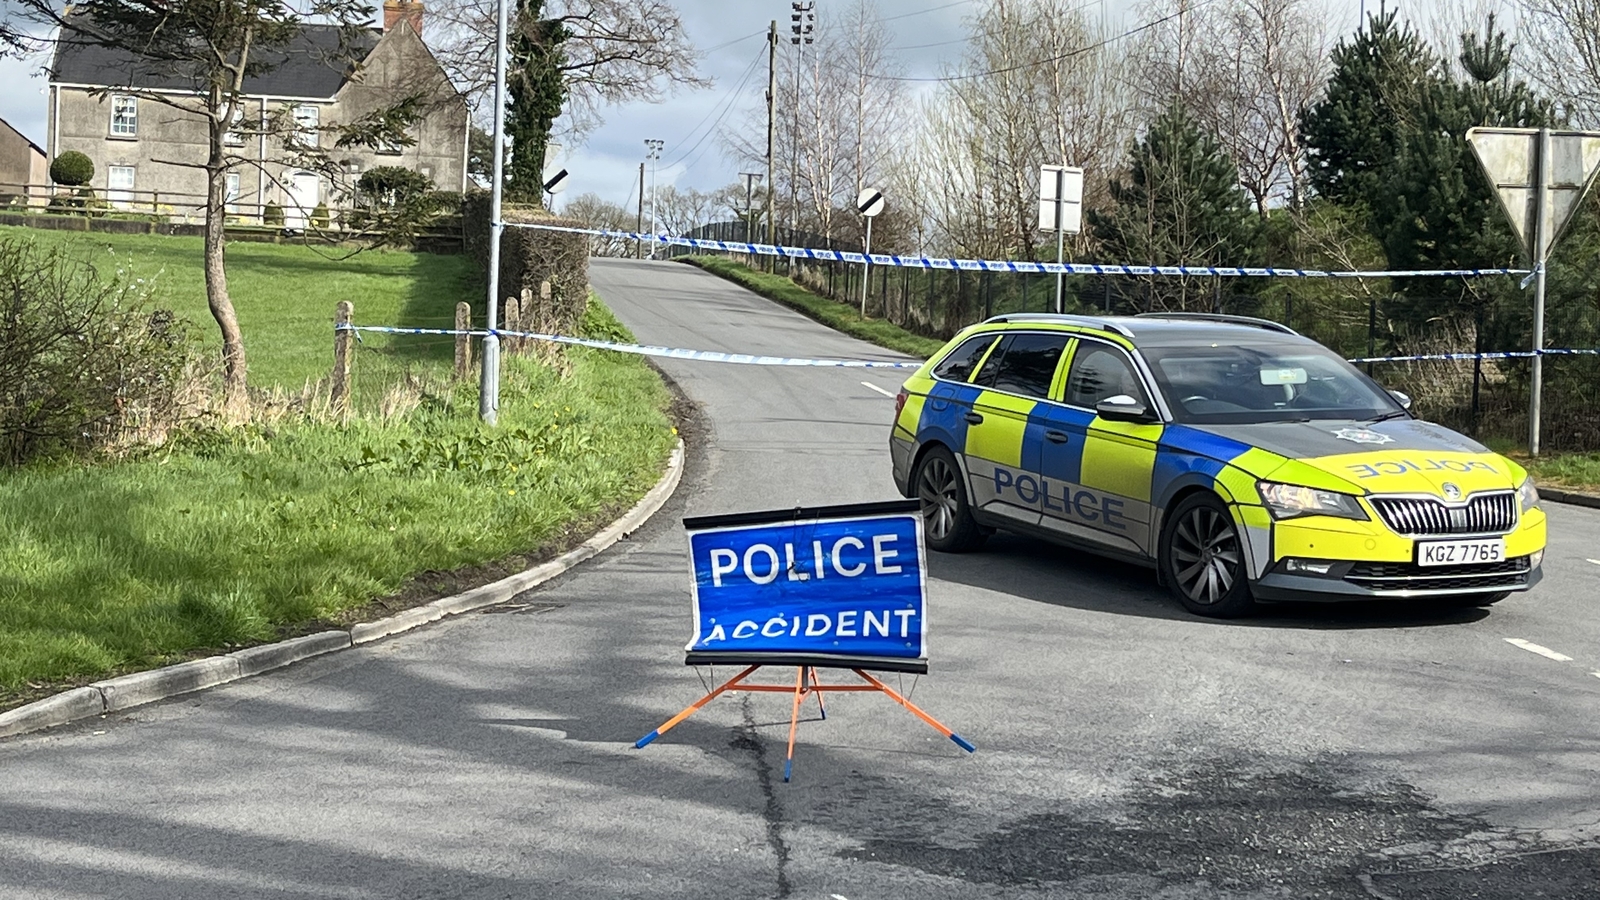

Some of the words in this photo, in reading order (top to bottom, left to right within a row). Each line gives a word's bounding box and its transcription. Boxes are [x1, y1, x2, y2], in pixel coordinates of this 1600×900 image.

[994, 467, 1126, 530] POLICE
[709, 534, 902, 587] POLICE
[1425, 545, 1455, 562] KGZ
[1460, 544, 1499, 561] 7765
[702, 610, 916, 643] ACCIDENT
